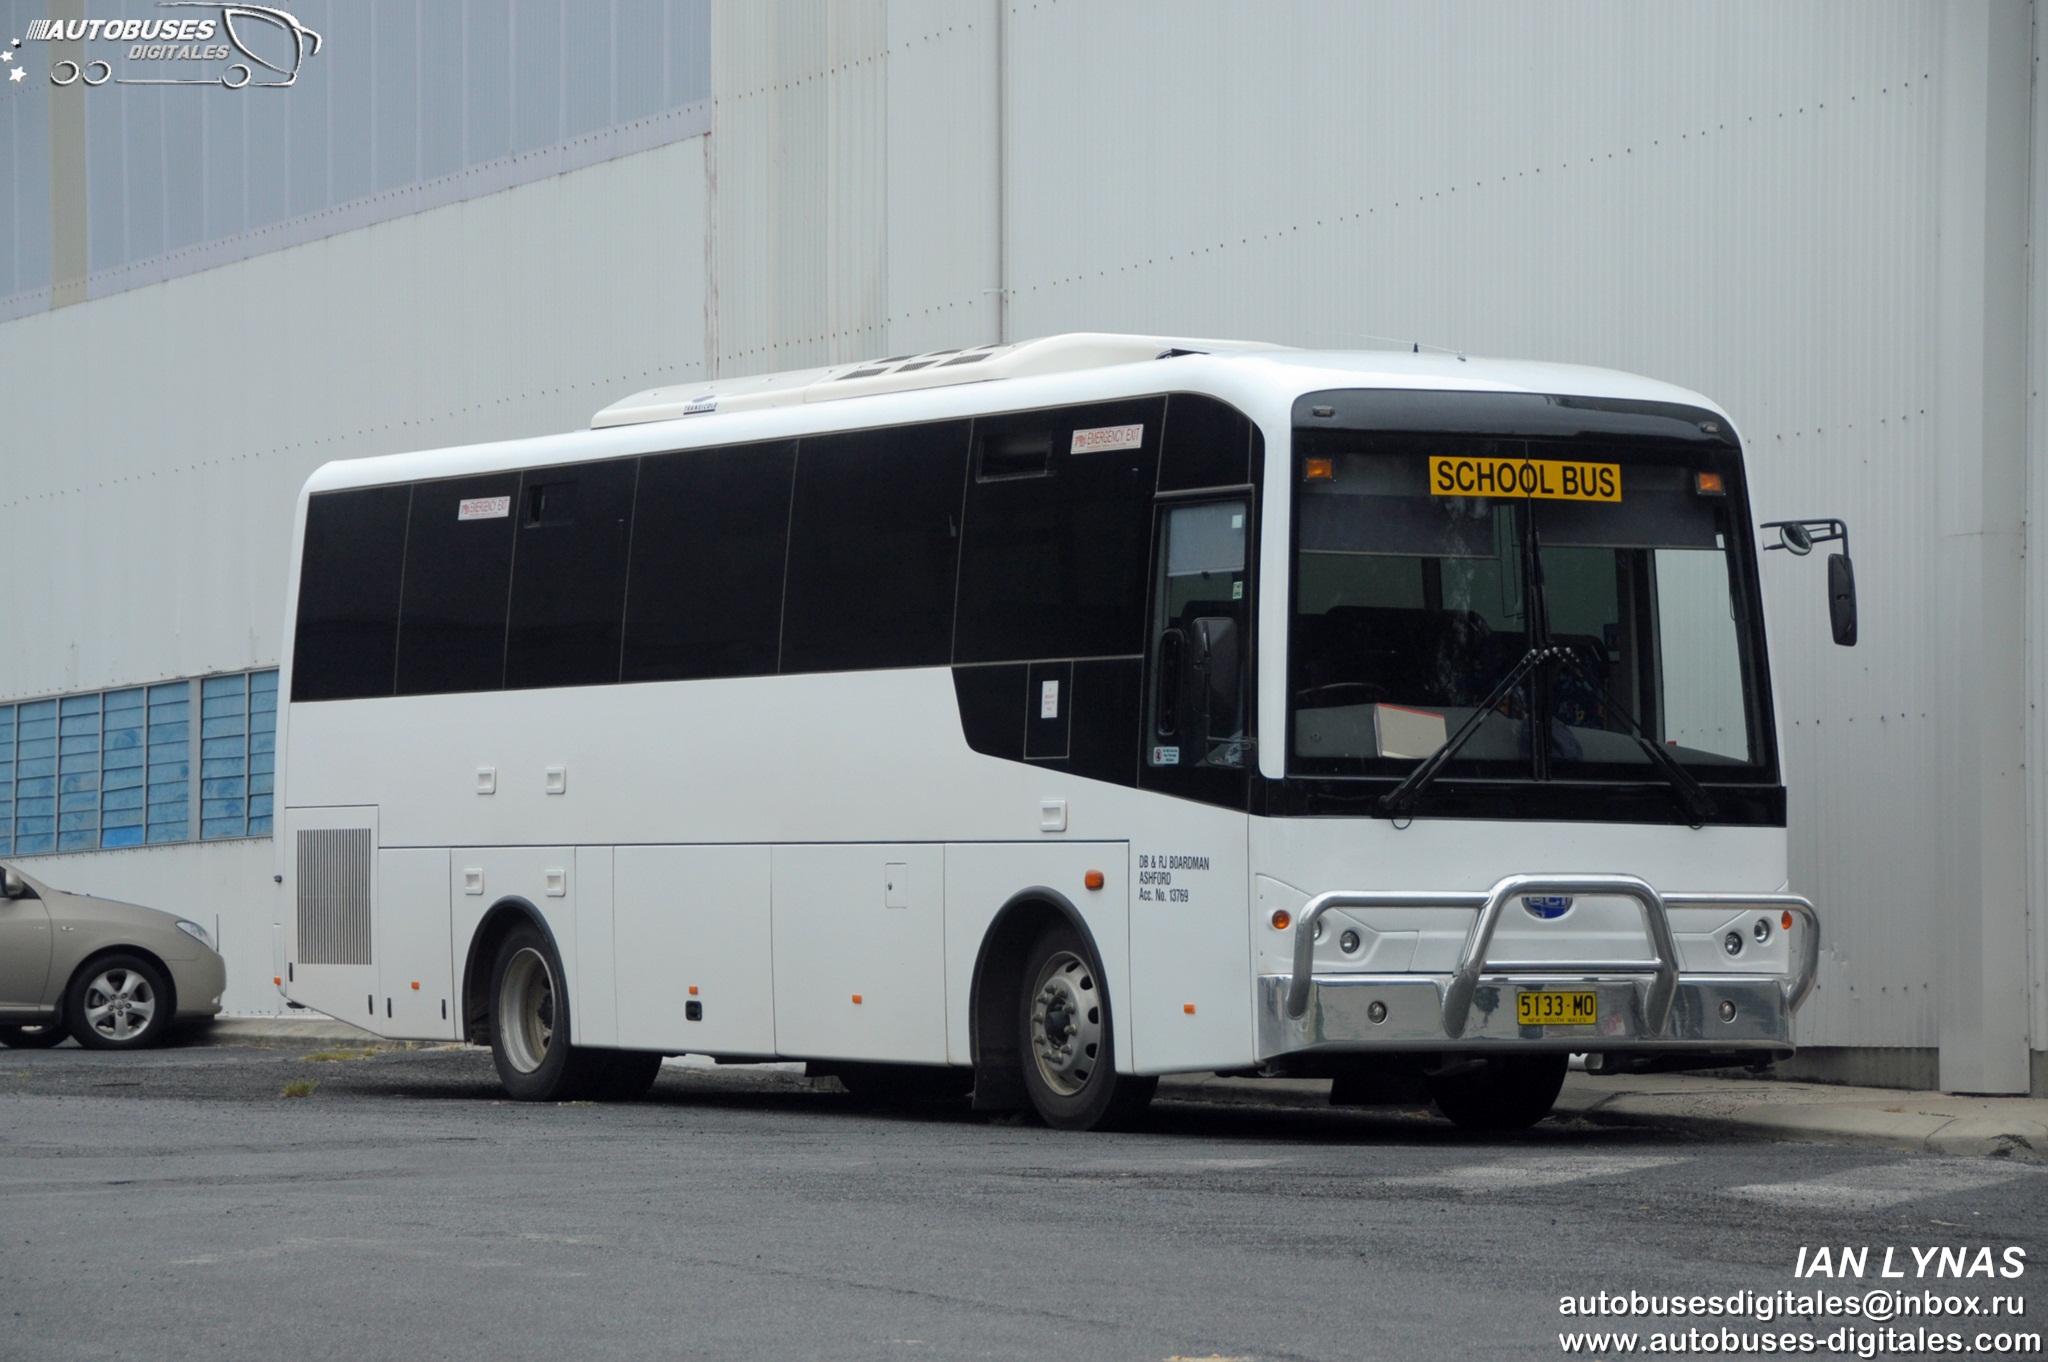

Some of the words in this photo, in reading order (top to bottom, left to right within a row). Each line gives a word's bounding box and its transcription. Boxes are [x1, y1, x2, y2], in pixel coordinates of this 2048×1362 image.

[1087, 429, 1124, 445] EMERGENCY
[1126, 428, 1140, 441] EXIT
[1437, 460, 1554, 494] SCHOOL
[1562, 465, 1615, 497] BUS
[1139, 855, 1149, 868] DB
[1151, 855, 1156, 868] &
[1159, 855, 1167, 869] RJ
[1169, 855, 1209, 870] BOARDMAN
[1139, 871, 1171, 885] ASHFORD
[1139, 887, 1153, 901] Acc.
[1156, 888, 1166, 902] No.
[1169, 889, 1188, 902] 13769
